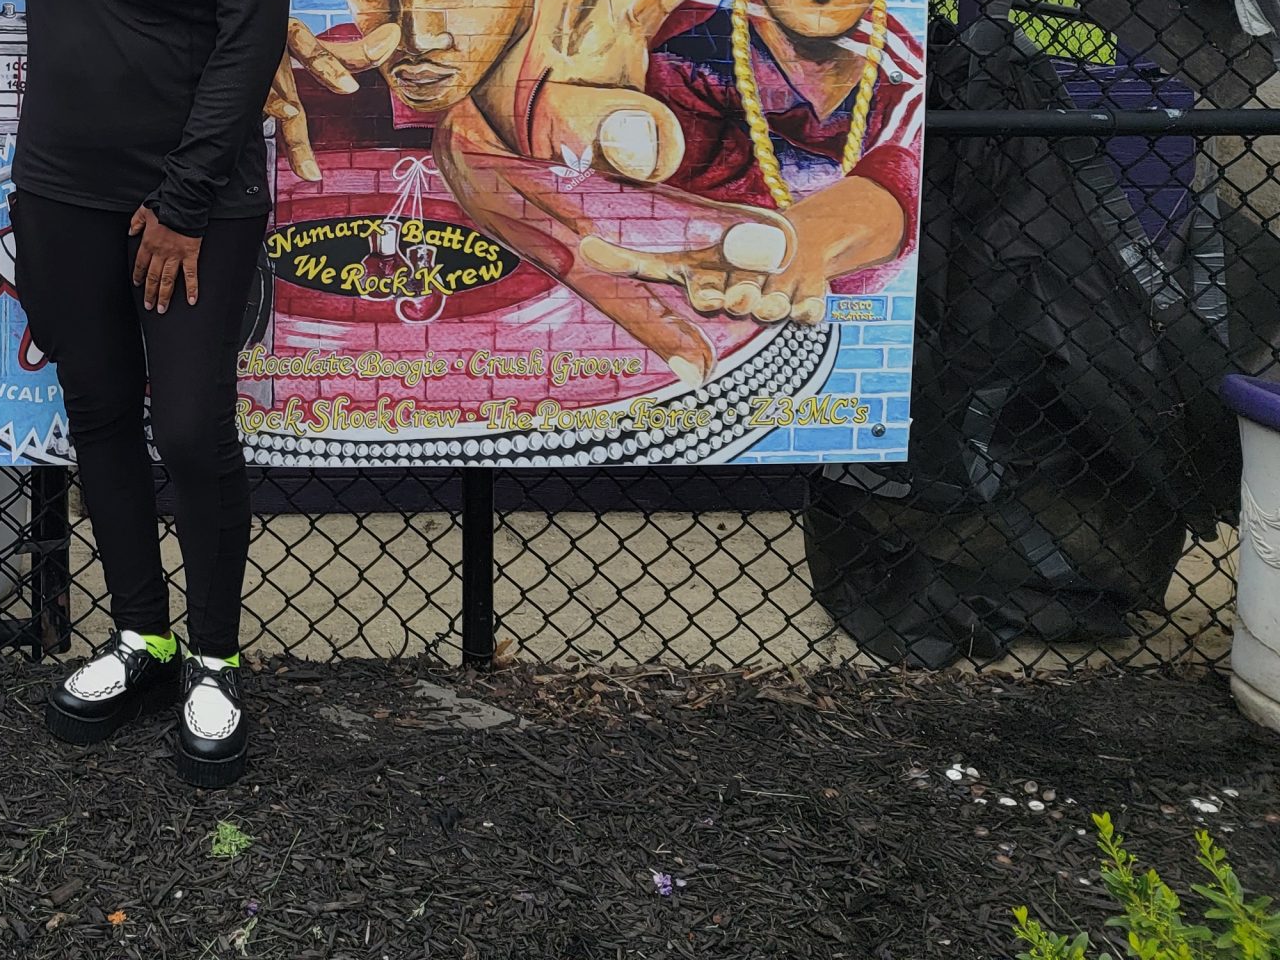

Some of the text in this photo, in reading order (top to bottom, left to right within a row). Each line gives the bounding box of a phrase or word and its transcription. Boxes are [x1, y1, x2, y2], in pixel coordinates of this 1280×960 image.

[268, 217, 500, 261] Numarx Battles
[293, 254, 503, 296] We Rock Krew
[237, 344, 642, 386] Chocolate Boogie Crush Groove
[236, 397, 306, 436] Rock
[309, 396, 399, 432] Shock
[396, 399, 461, 430] Crew
[480, 397, 532, 430] The
[536, 400, 625, 431] Power
[629, 397, 712, 429] Force
